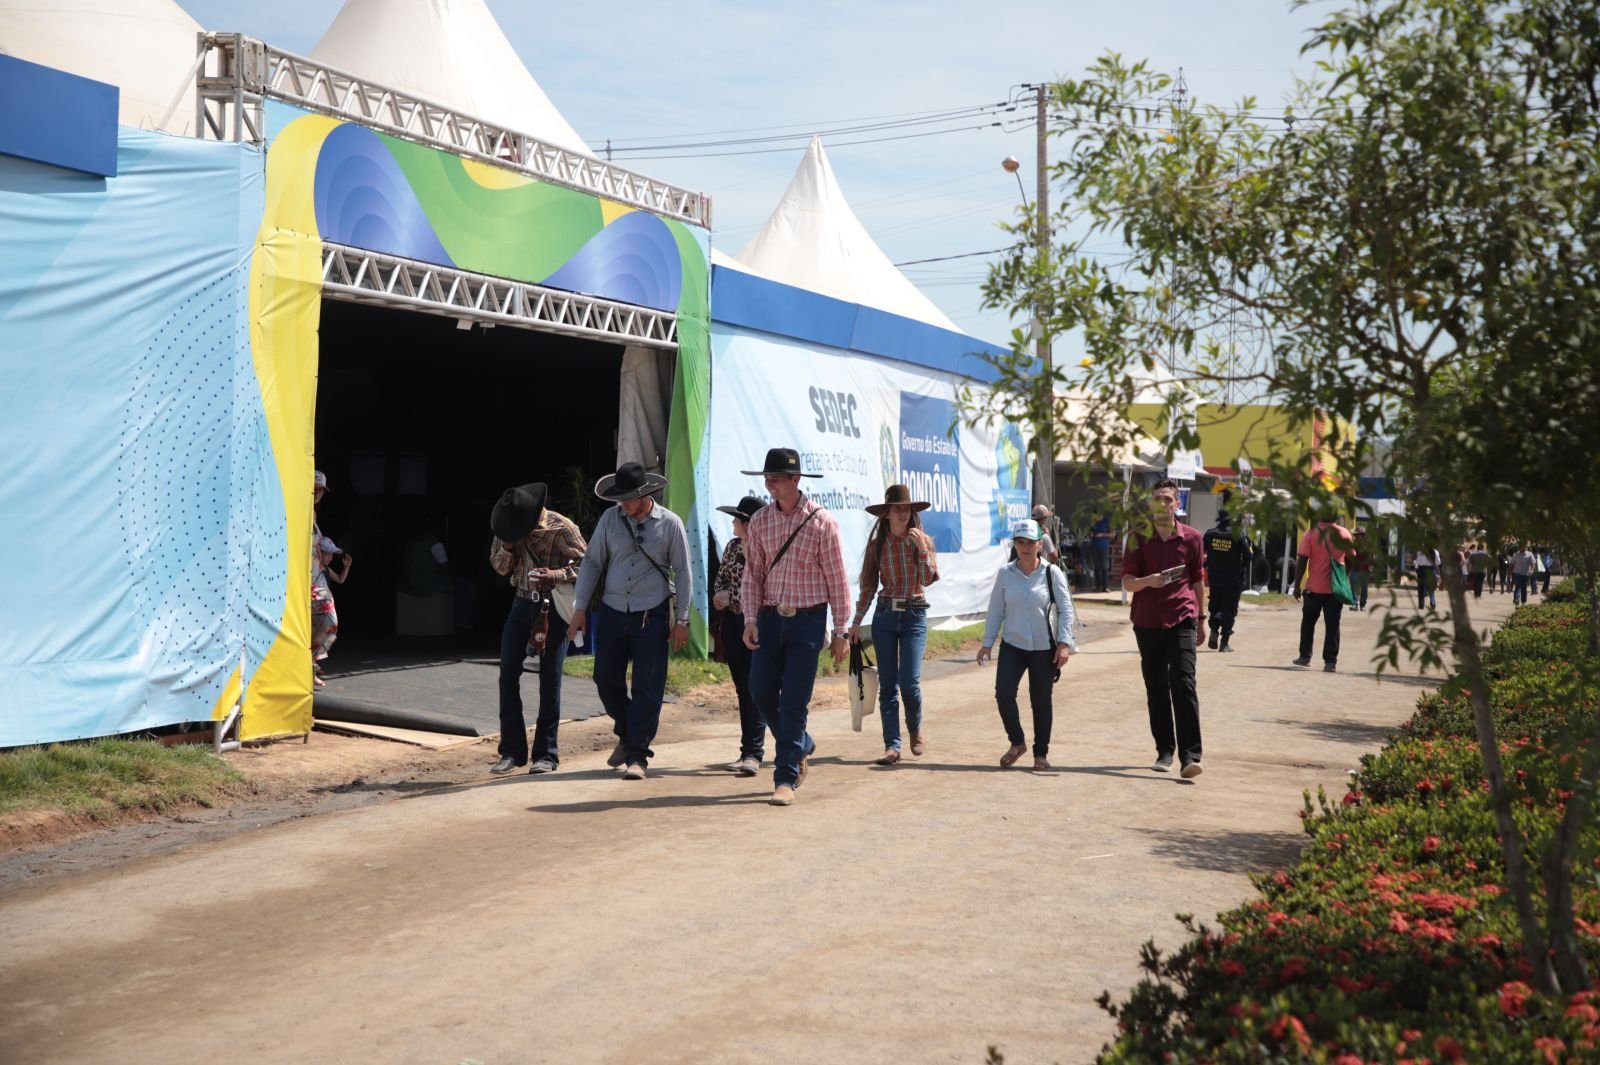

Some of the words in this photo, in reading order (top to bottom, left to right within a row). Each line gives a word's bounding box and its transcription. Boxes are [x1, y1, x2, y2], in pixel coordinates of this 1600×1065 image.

[808, 385, 861, 439] SEDEC
[902, 431, 925, 453] Governo
[925, 435, 932, 454] do
